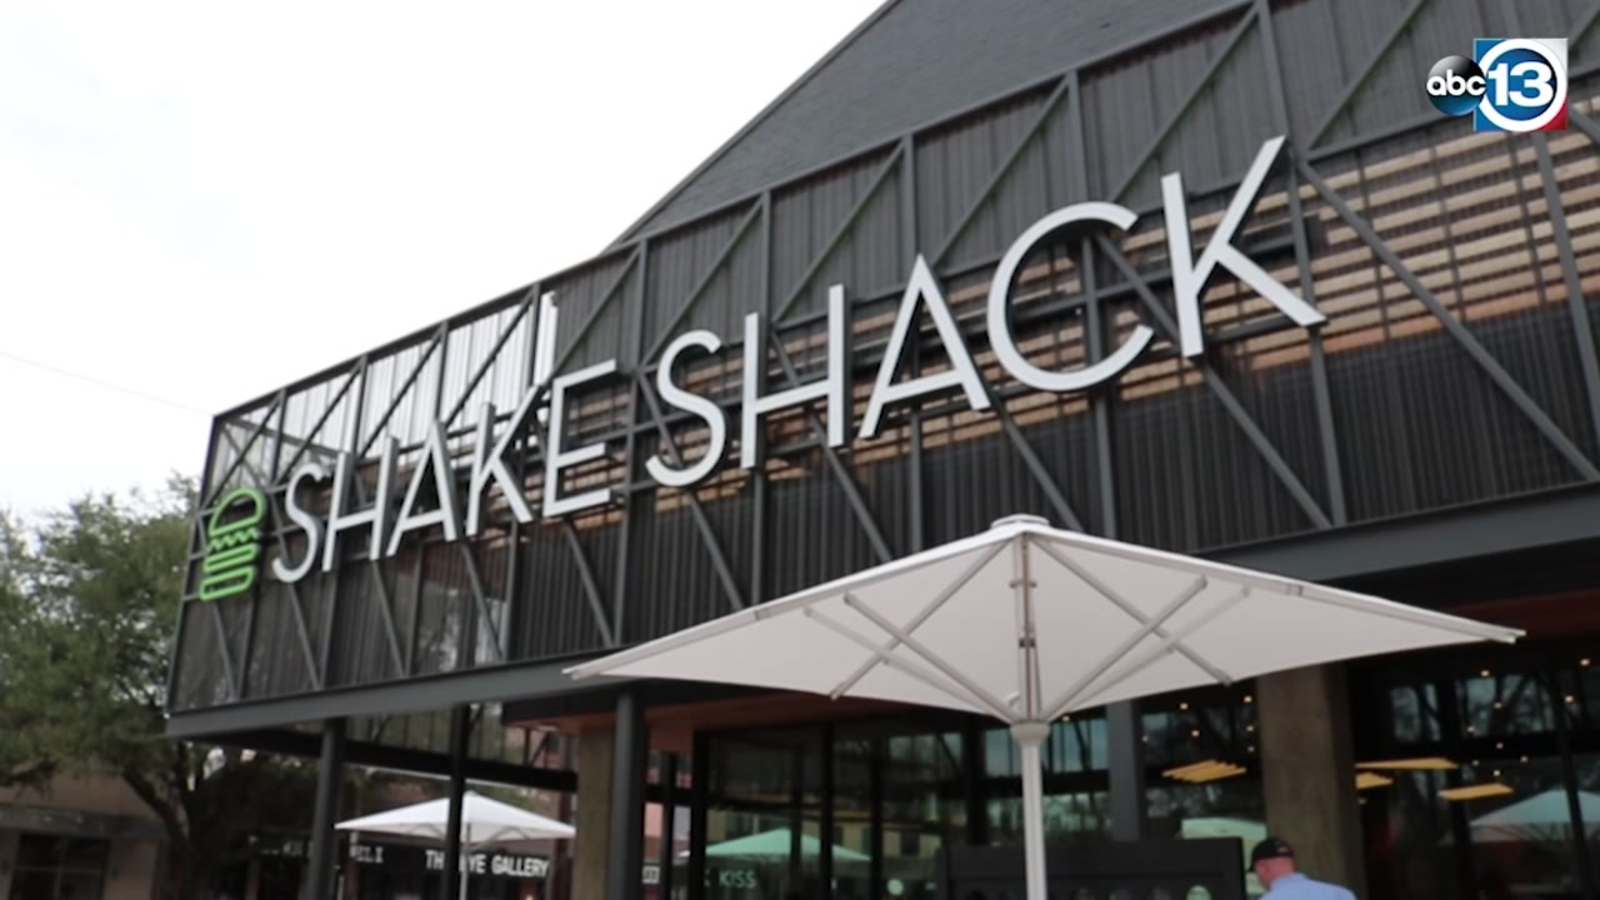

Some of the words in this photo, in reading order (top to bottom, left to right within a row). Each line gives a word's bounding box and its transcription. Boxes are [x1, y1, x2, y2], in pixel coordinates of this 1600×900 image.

[272, 358, 617, 583] SHAKE
[645, 134, 1327, 488] SHACK
[425, 848, 449, 872] TH
[491, 854, 549, 878] GALLERY
